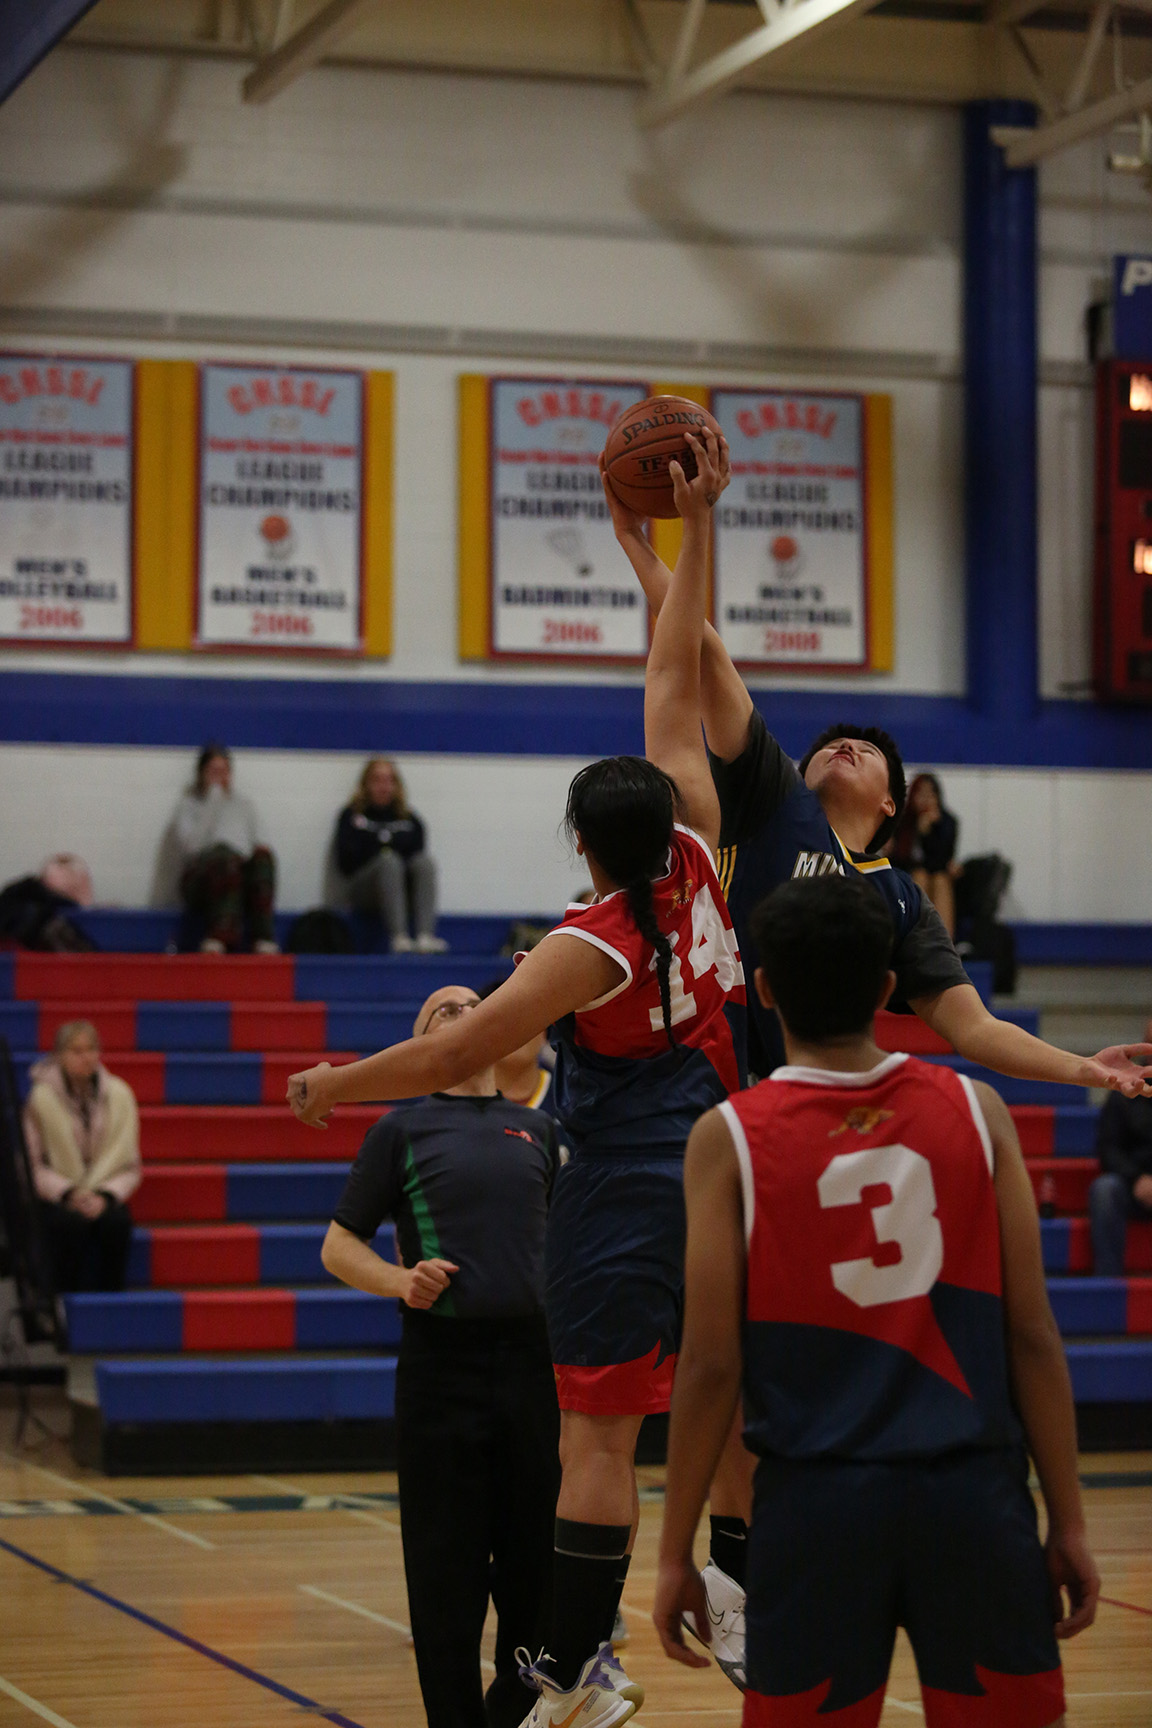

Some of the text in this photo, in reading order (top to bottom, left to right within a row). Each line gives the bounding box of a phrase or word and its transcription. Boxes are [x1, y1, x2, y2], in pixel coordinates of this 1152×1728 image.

[621, 411, 707, 446] SPALDING
[647, 881, 746, 1033] 14
[816, 1142, 944, 1309] 3
